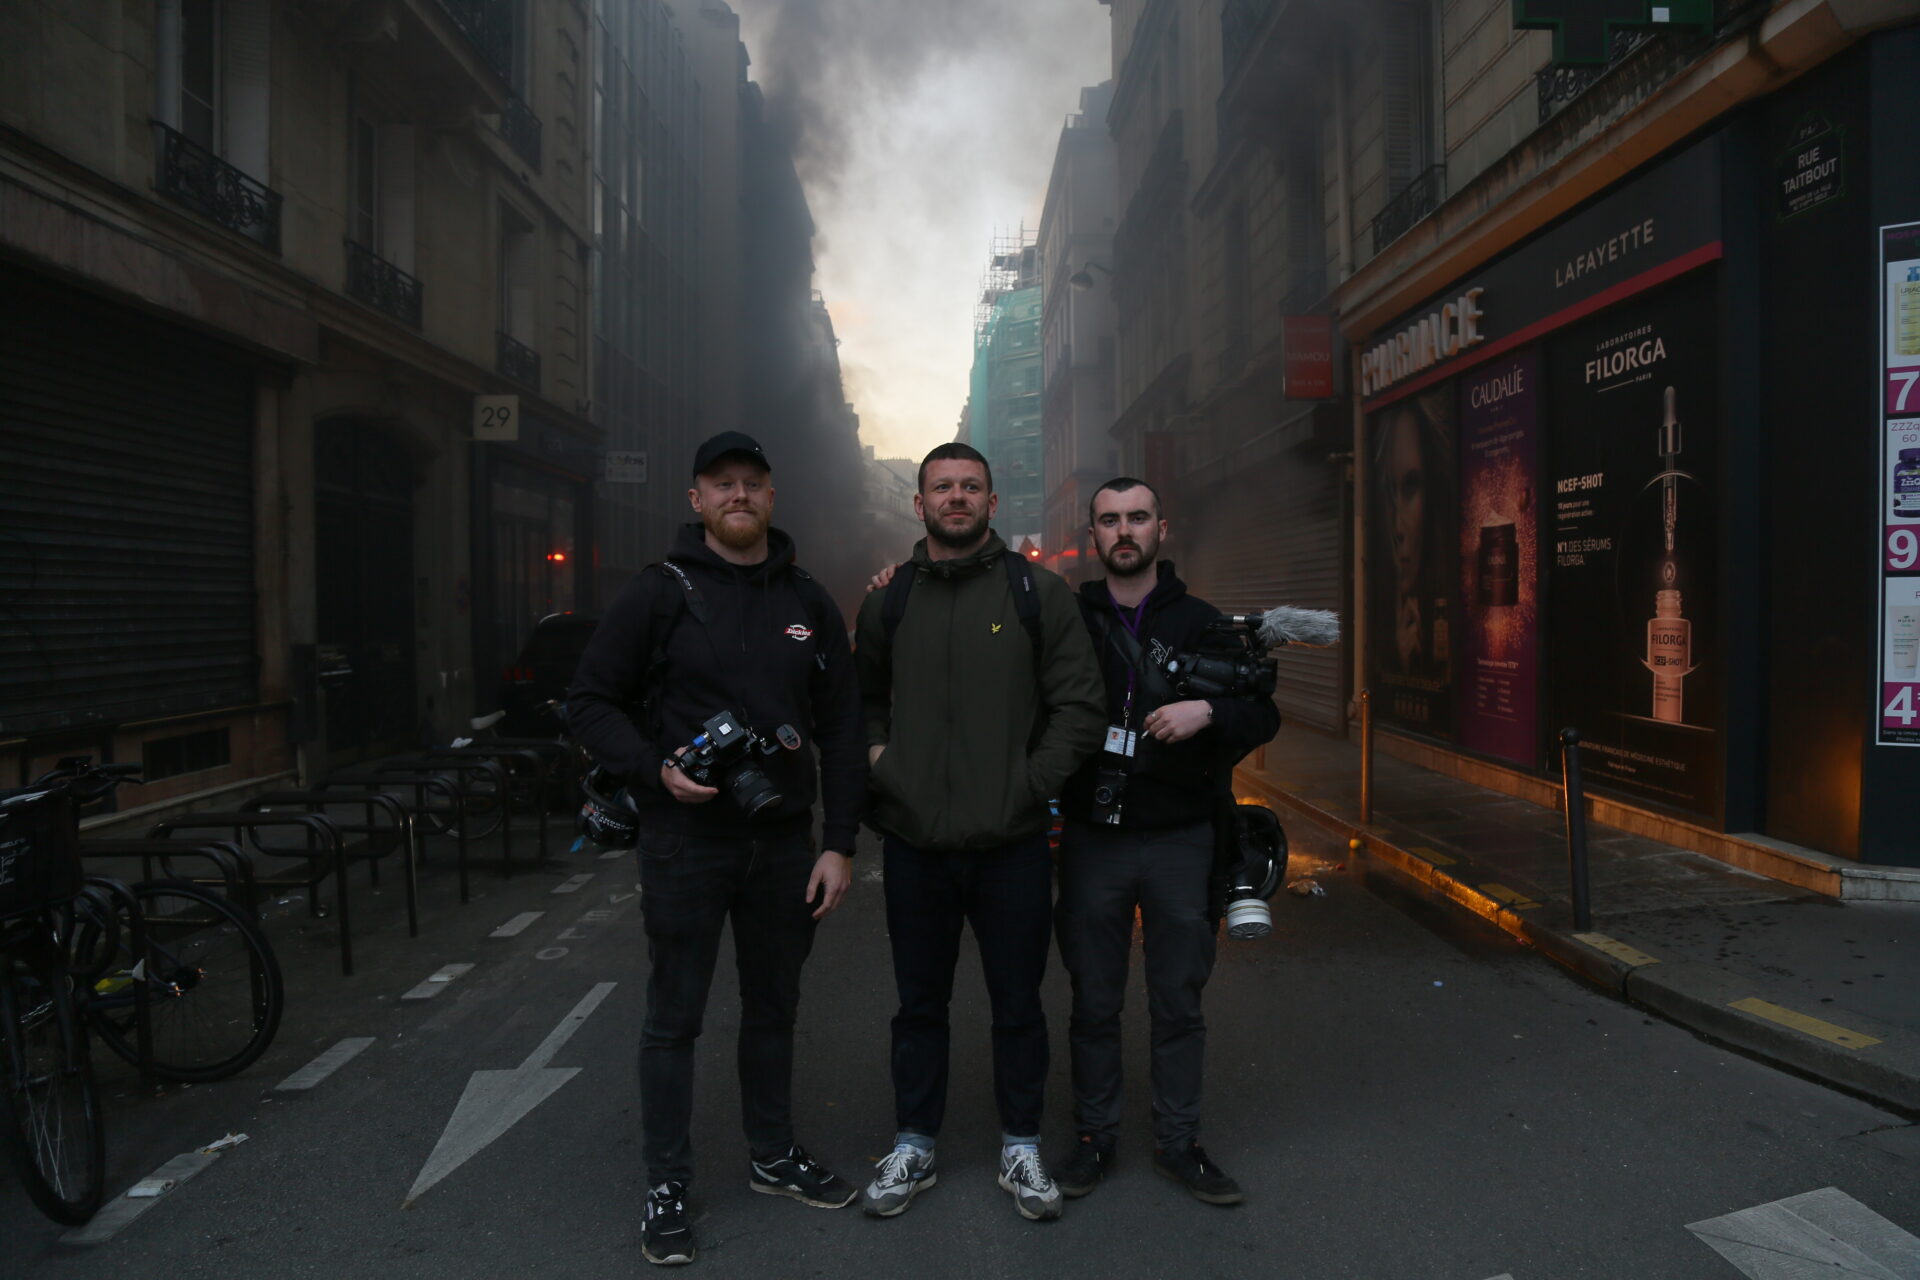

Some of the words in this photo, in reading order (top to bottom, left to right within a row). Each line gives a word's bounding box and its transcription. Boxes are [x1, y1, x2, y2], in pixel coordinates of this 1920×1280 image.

[1797, 146, 1820, 170] RUE
[1783, 157, 1838, 194] TAITBOUT
[1555, 218, 1655, 289] LAFAYETTE
[1596, 324, 1652, 352] LABORATOIRES
[1585, 337, 1667, 384] FILORGA
[1889, 371, 1920, 411] 7
[481, 406, 511, 428] 29
[1557, 472, 1604, 494] NCEF-SHOT
[1569, 539, 1582, 553] DES
[1582, 537, 1612, 552] SÉRUMS
[1887, 529, 1919, 569] 9
[1651, 632, 1688, 647] FILORGA
[1883, 685, 1918, 726] 4
